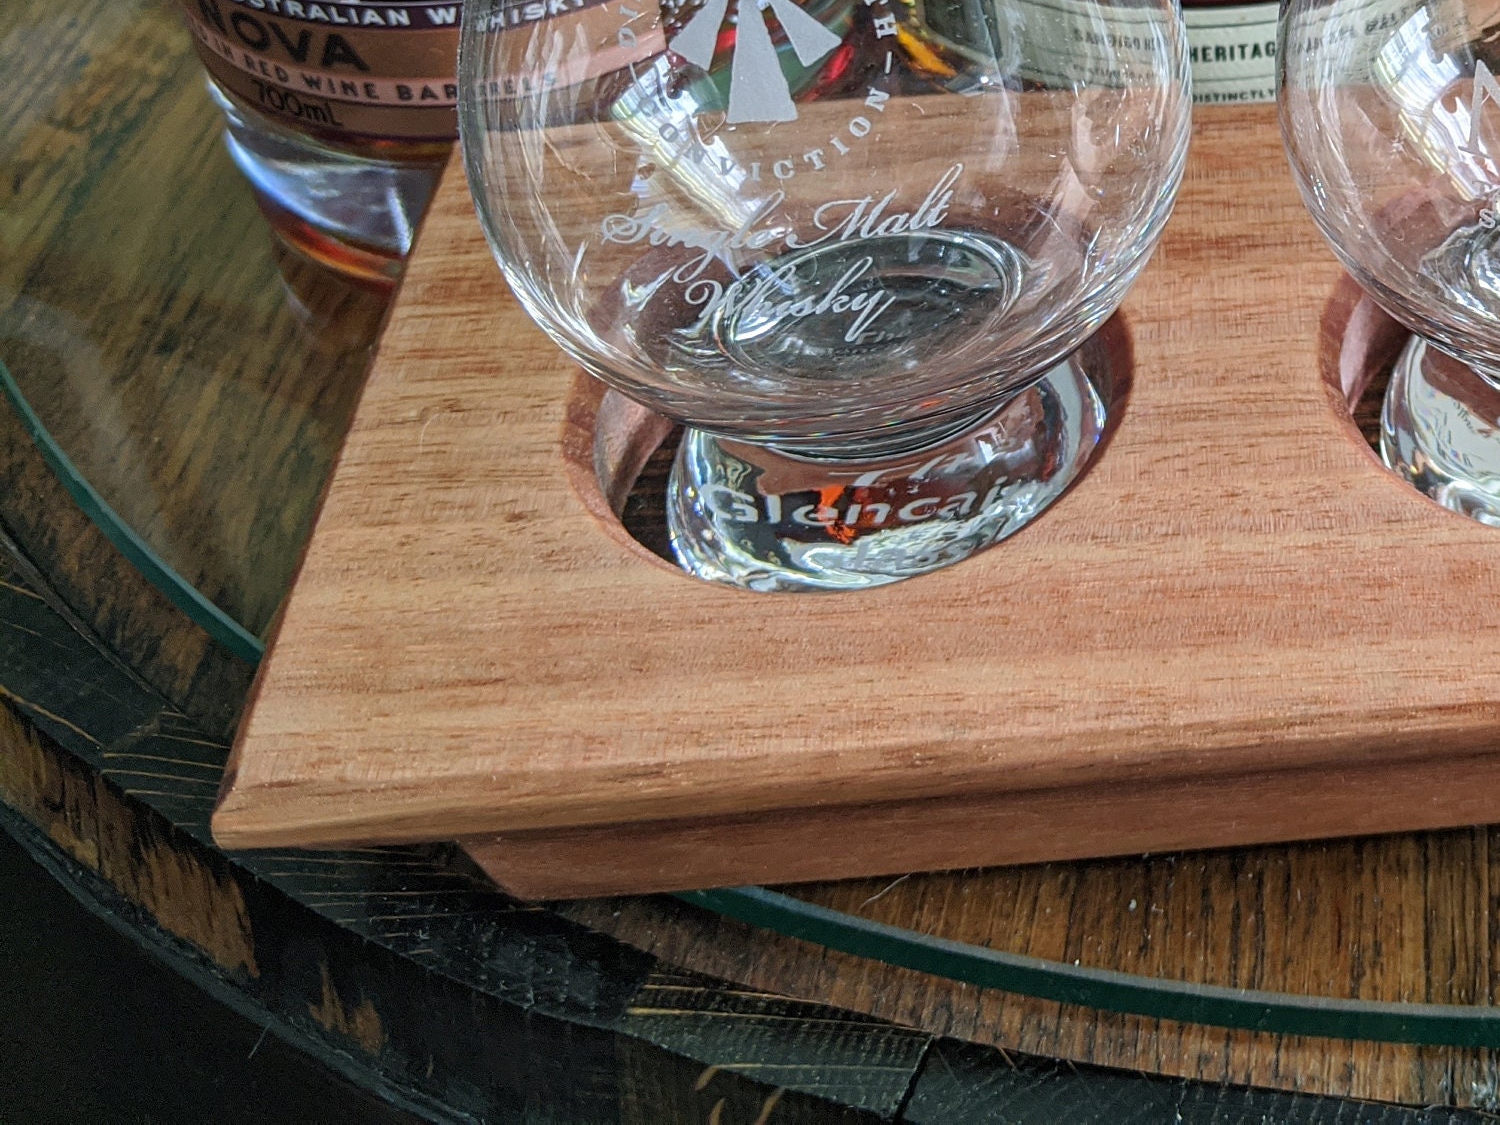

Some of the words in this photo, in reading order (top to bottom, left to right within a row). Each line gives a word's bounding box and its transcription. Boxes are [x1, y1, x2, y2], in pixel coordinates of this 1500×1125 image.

[244, 55, 290, 84] RED
[301, 73, 380, 101] WINE
[1189, 39, 1276, 64] HERITAG
[790, 163, 965, 250] Malt
[685, 256, 896, 344] Whisky
